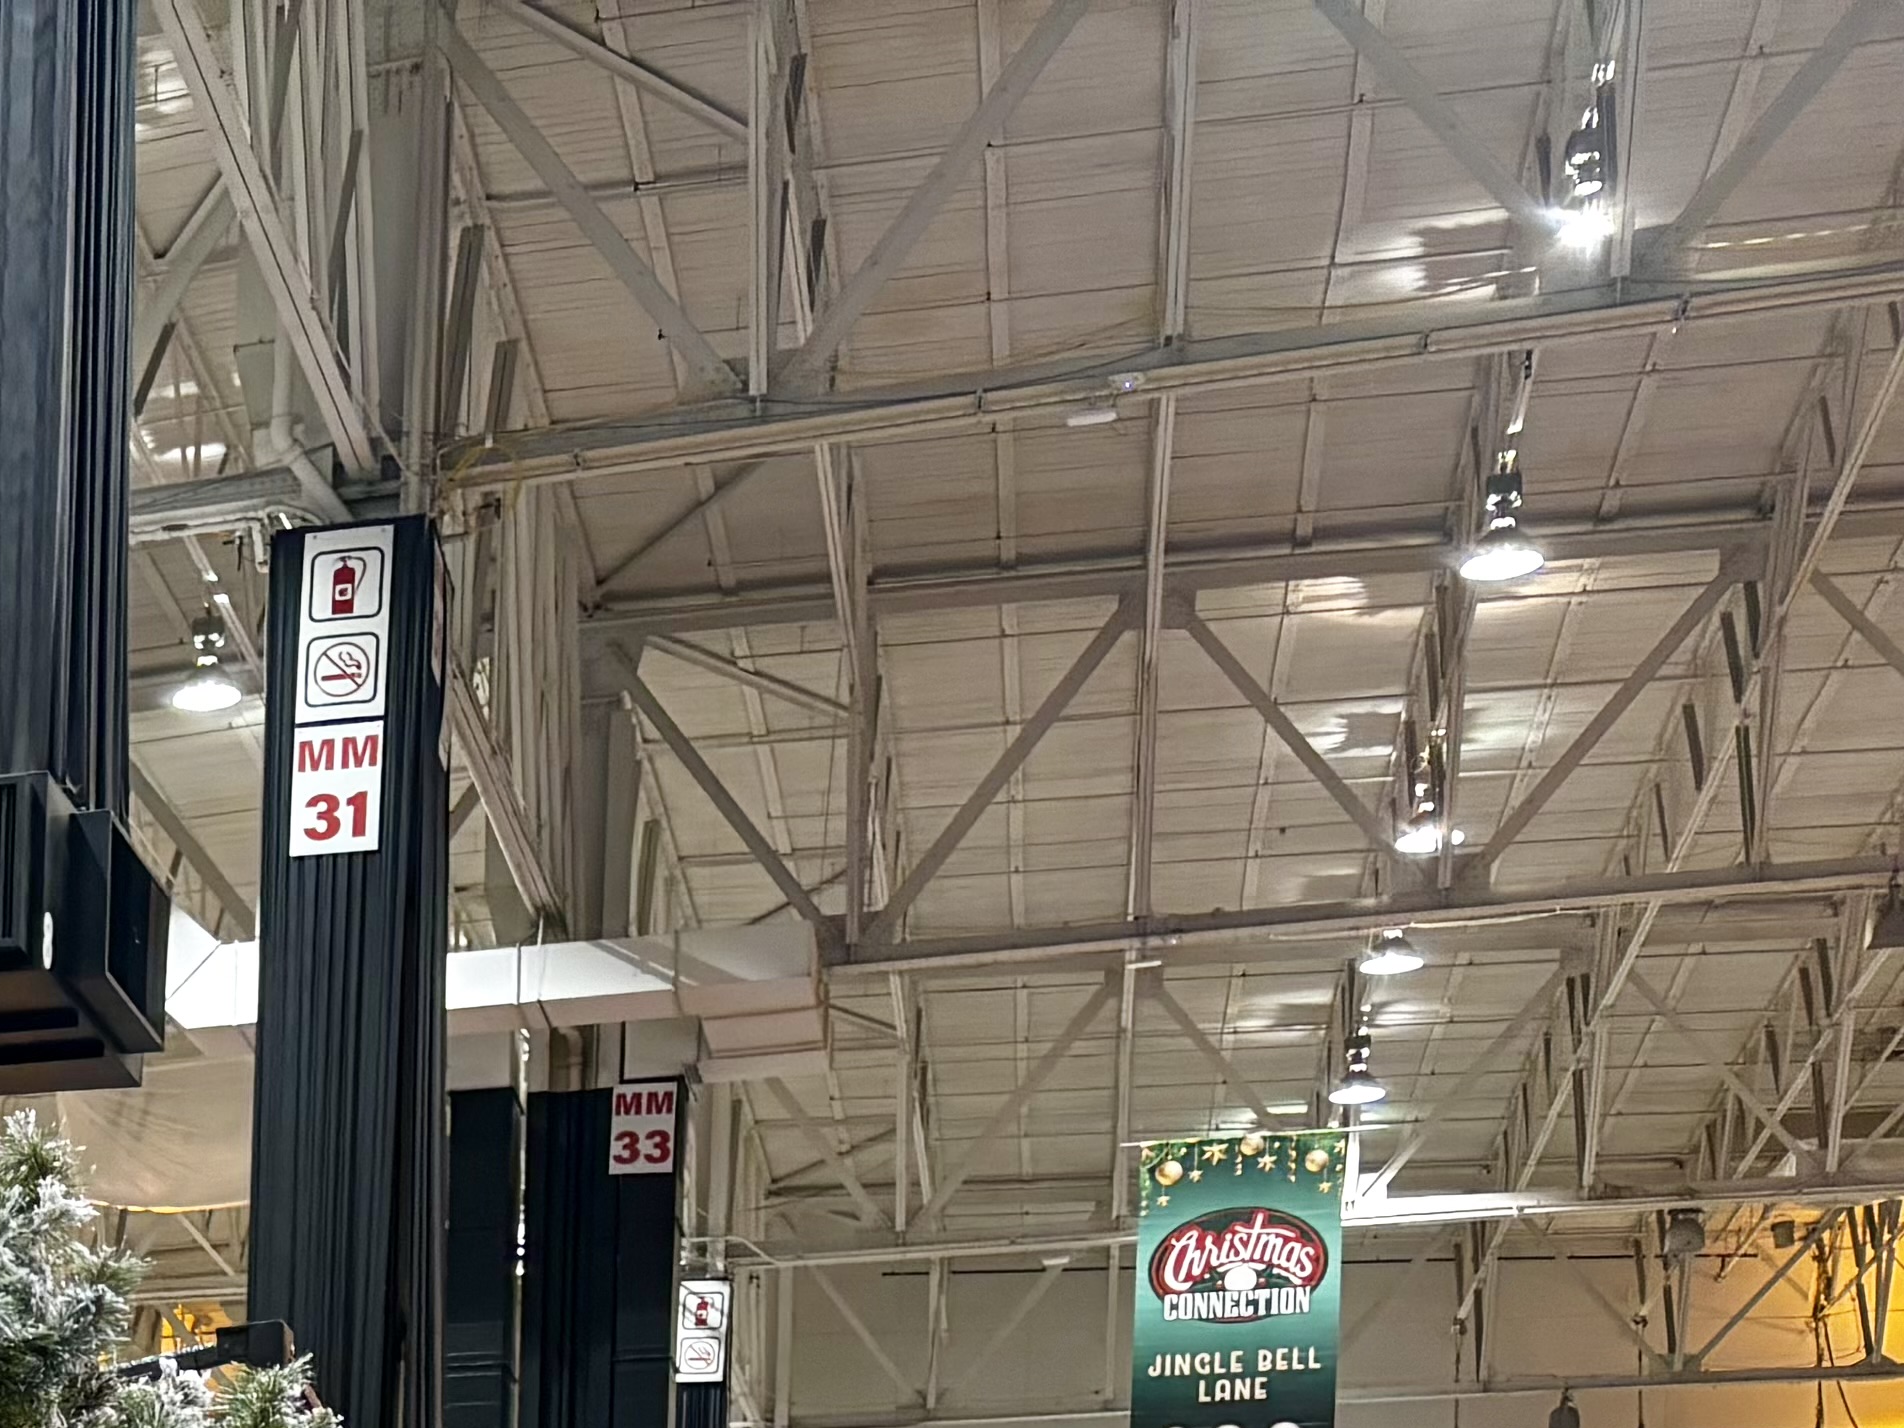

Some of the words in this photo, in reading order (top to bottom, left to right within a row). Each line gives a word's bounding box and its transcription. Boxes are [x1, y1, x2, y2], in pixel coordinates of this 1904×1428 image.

[298, 734, 379, 772] MM
[303, 790, 368, 840] 31
[614, 1091, 674, 1116] MM
[612, 1130, 671, 1164] 33
[1164, 1212, 1315, 1291] Christmas
[1163, 1286, 1311, 1321] CONNECTION
[1148, 1351, 1244, 1377] JINGLE
[1257, 1346, 1322, 1372] BELL
[1198, 1377, 1268, 1403] LANE
